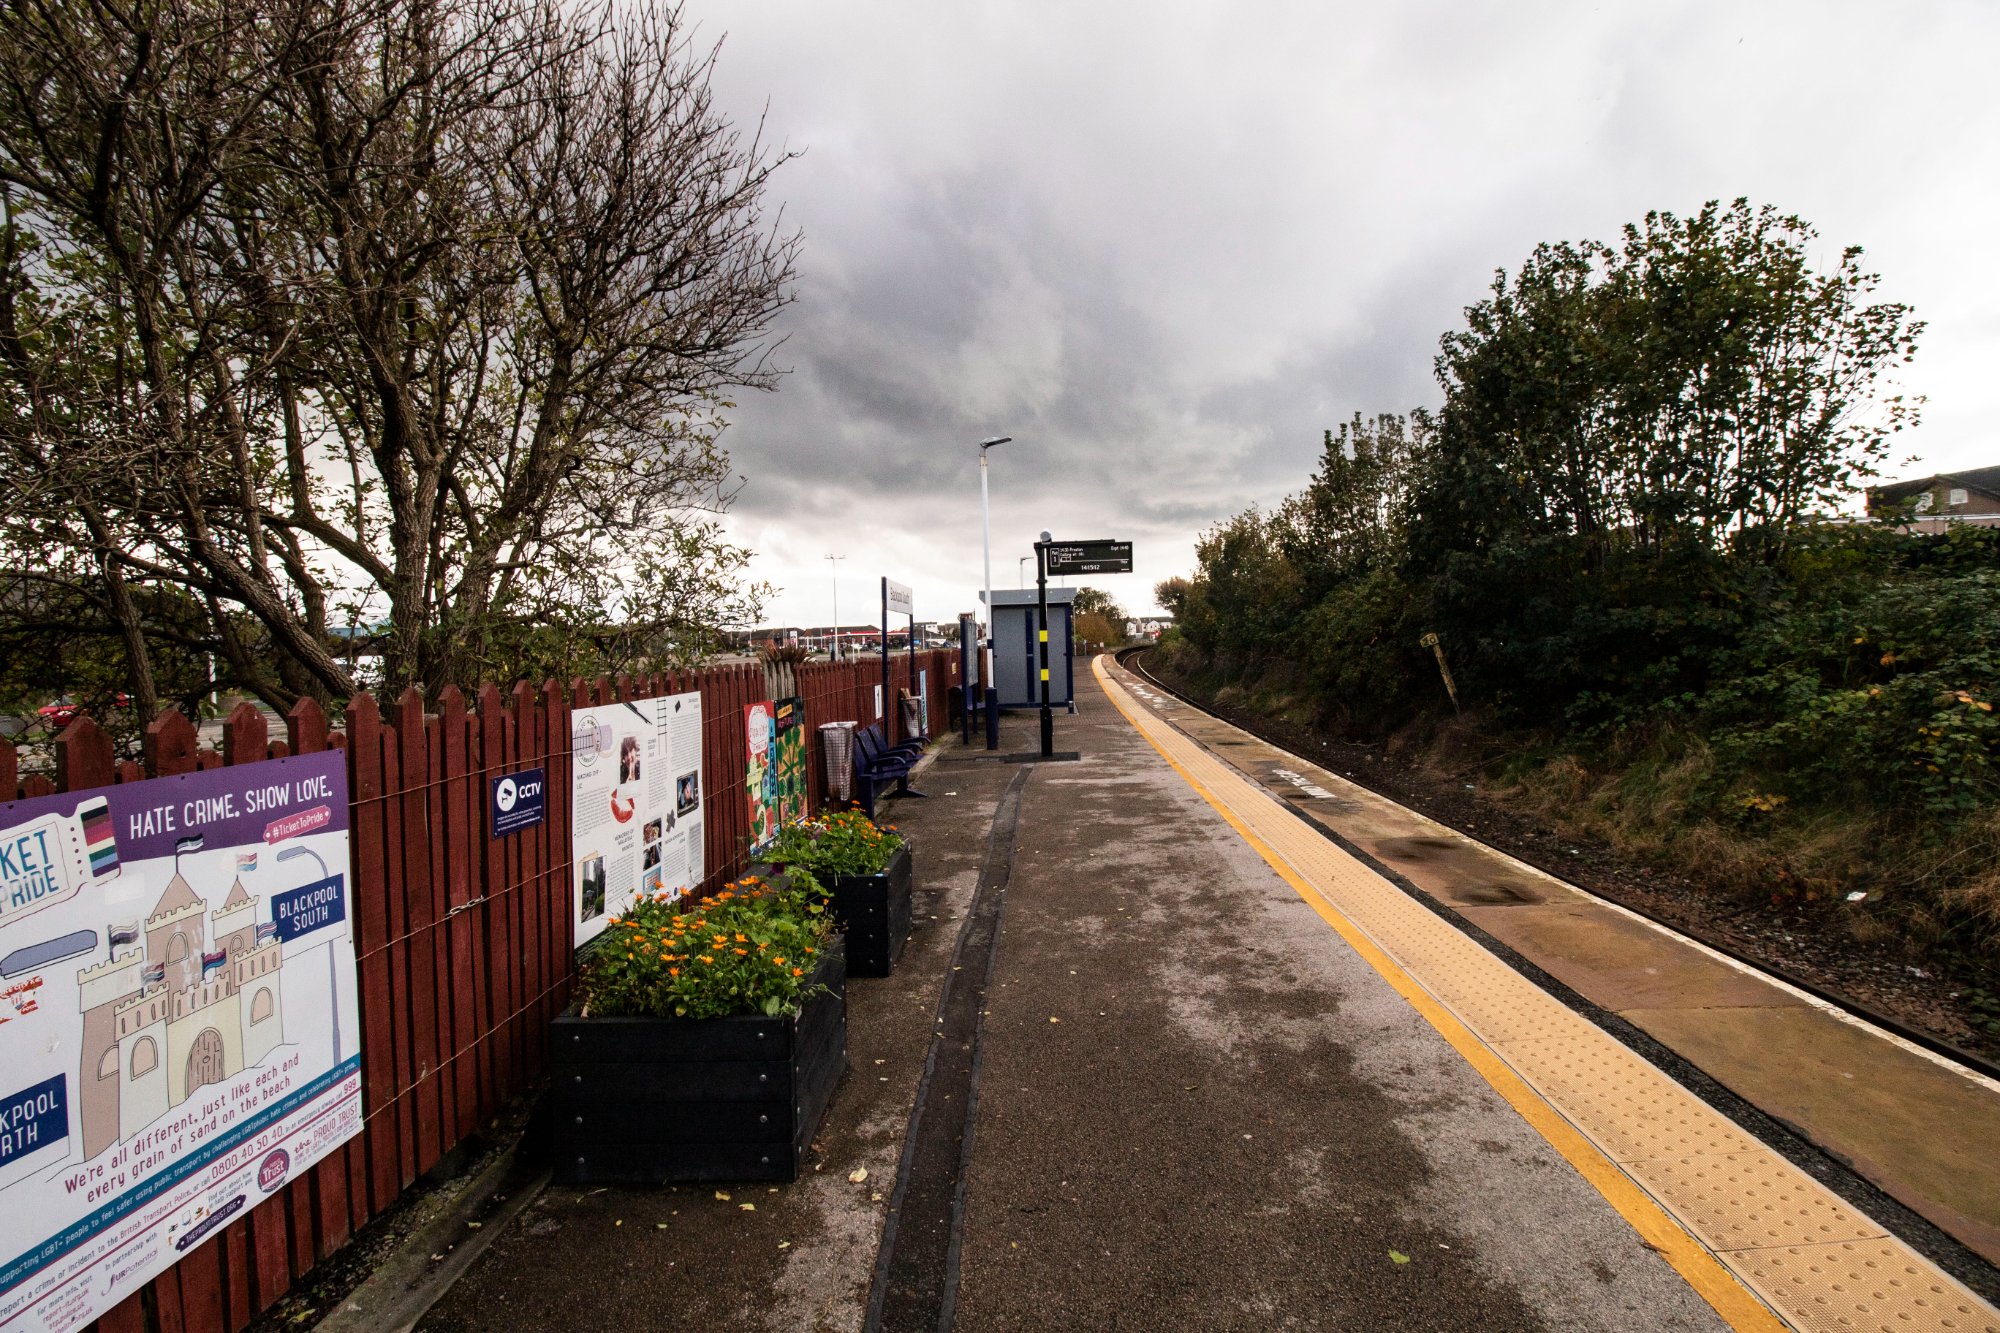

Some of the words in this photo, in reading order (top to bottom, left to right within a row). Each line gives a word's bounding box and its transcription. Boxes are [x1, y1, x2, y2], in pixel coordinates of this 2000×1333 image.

[130, 805, 176, 840] HATE
[184, 794, 240, 827] CRIME.
[245, 782, 290, 813] SHOW
[296, 775, 333, 802] LOVE.
[519, 782, 541, 799] CCTV
[272, 813, 324, 838] #TicketToPride
[280, 884, 338, 918] BLACKPOOL
[294, 905, 328, 932] SOUTH
[1, 1122, 38, 1157] RTH
[65, 1165, 104, 1194] We're
[112, 1148, 127, 1168] all
[202, 1094, 226, 1120] just
[232, 1082, 250, 1101] like
[256, 1065, 278, 1087] each
[282, 1052, 299, 1072] and
[88, 1172, 125, 1202] every
[132, 1150, 164, 1180] grain
[170, 1134, 182, 1154] of
[190, 1116, 216, 1142] sand
[222, 1109, 235, 1124] on
[240, 1096, 258, 1113] the
[262, 1076, 290, 1100] beach
[314, 1118, 336, 1140] PROUD
[262, 1160, 285, 1182] Trust
[0, 1296, 24, 1317] report
[28, 1291, 32, 1299] a
[35, 1277, 55, 1294] crime
[58, 1270, 66, 1279] or
[68, 1250, 95, 1272] incident
[98, 1245, 105, 1253] to
[107, 1236, 118, 1247] the
[120, 1218, 141, 1238] British
[144, 1202, 172, 1224] Transport
[212, 1154, 238, 1178] 0800
[241, 1144, 253, 1159] 40
[256, 1134, 268, 1150] 50
[344, 1078, 357, 1094] 999
[65, 1224, 88, 1246] people
[91, 1219, 99, 1227] to
[102, 1208, 114, 1220] feel
[116, 1197, 134, 1212] safer
[136, 1185, 152, 1200] using
[154, 1173, 172, 1191] public
[174, 1155, 202, 1177] transport
[203, 1150, 211, 1159] by
